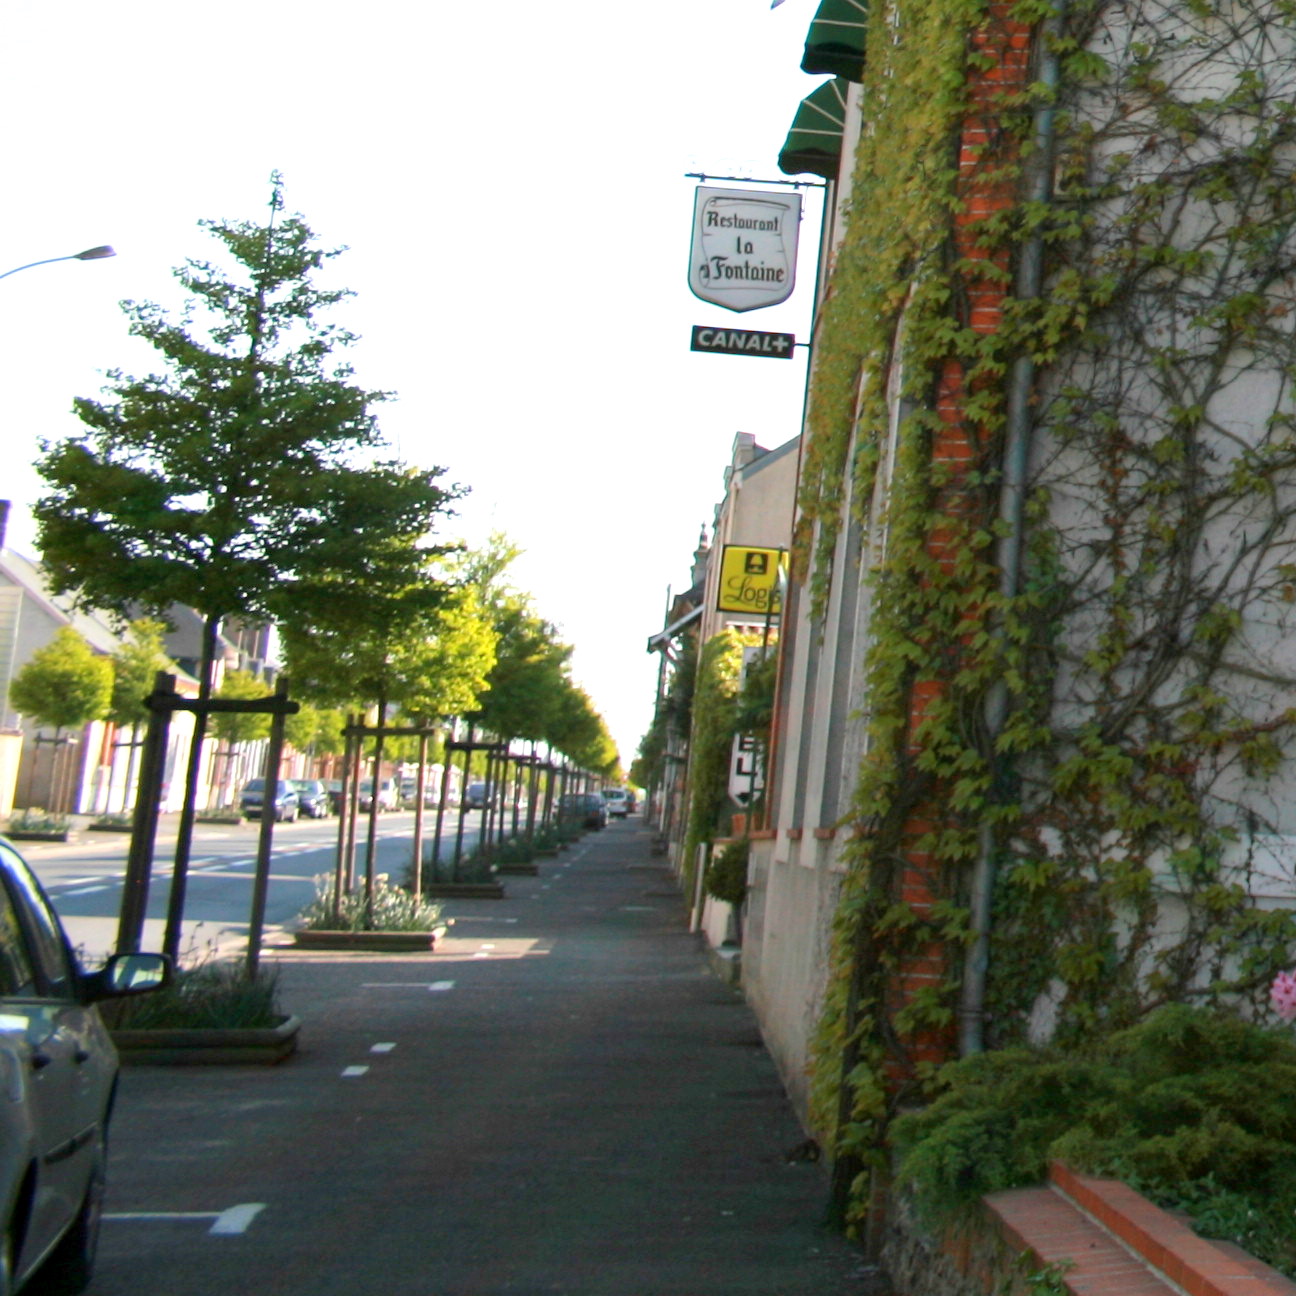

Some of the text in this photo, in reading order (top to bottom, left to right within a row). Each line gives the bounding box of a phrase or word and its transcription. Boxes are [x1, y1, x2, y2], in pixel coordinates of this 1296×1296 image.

[706, 211, 779, 232] Restaurant
[736, 236, 754, 254] la
[708, 256, 785, 283] Fontaine
[697, 330, 789, 353] CANAL+
